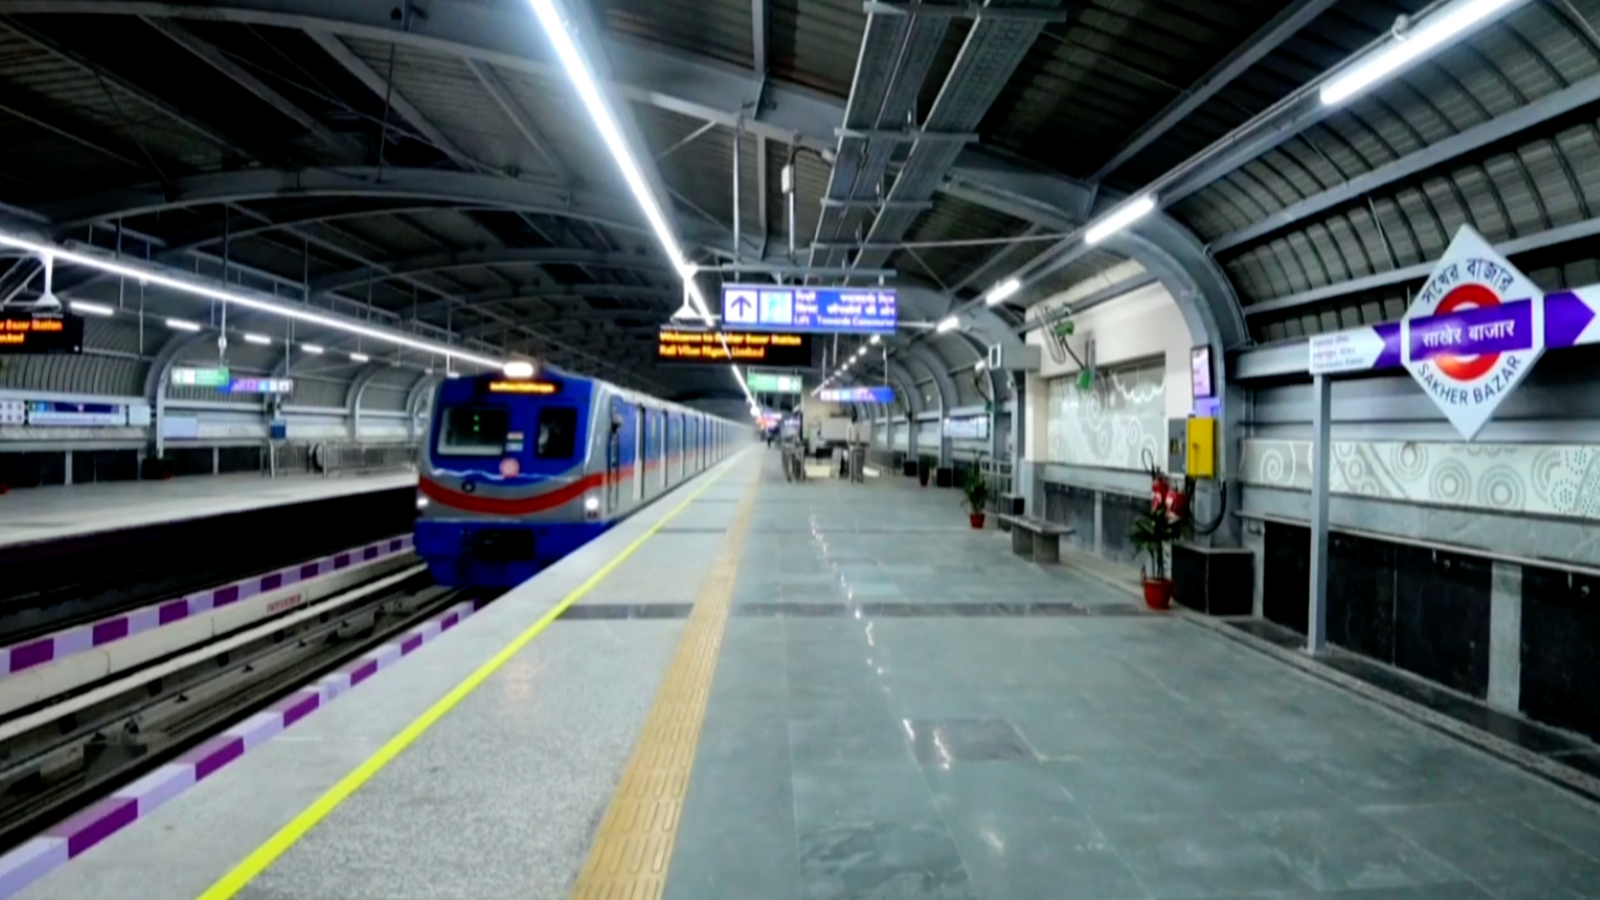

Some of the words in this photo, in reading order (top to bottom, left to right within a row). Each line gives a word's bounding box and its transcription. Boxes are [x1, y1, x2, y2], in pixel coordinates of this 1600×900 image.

[1466, 258, 1515, 293] বাজার
[1423, 324, 1463, 348] साखेर
[1468, 320, 1515, 342] बाजार
[1418, 362, 1469, 405] SAKHER
[1472, 354, 1521, 404] BAZAR
